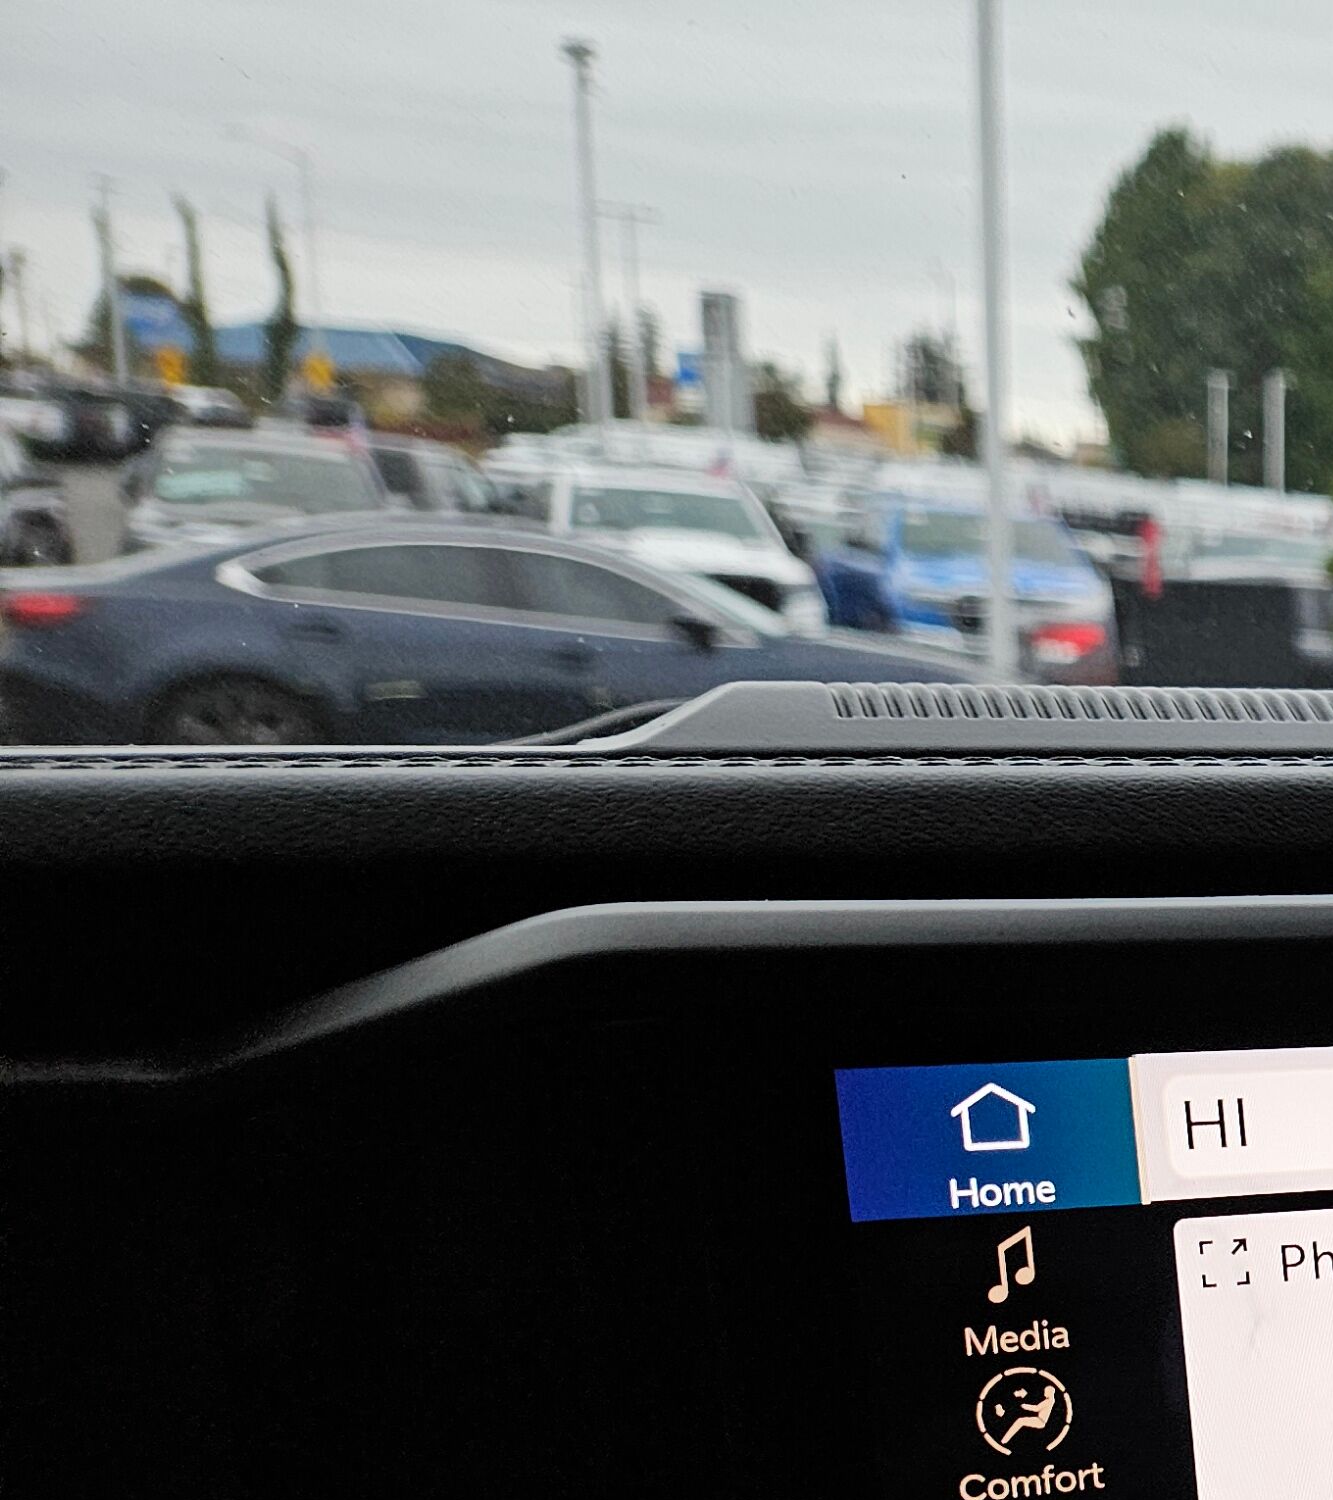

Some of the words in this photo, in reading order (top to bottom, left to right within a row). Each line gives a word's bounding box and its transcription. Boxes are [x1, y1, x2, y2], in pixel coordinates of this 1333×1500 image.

[1184, 1098, 1247, 1149] HI
[949, 1178, 1055, 1209] Home
[965, 1320, 1070, 1356] Media
